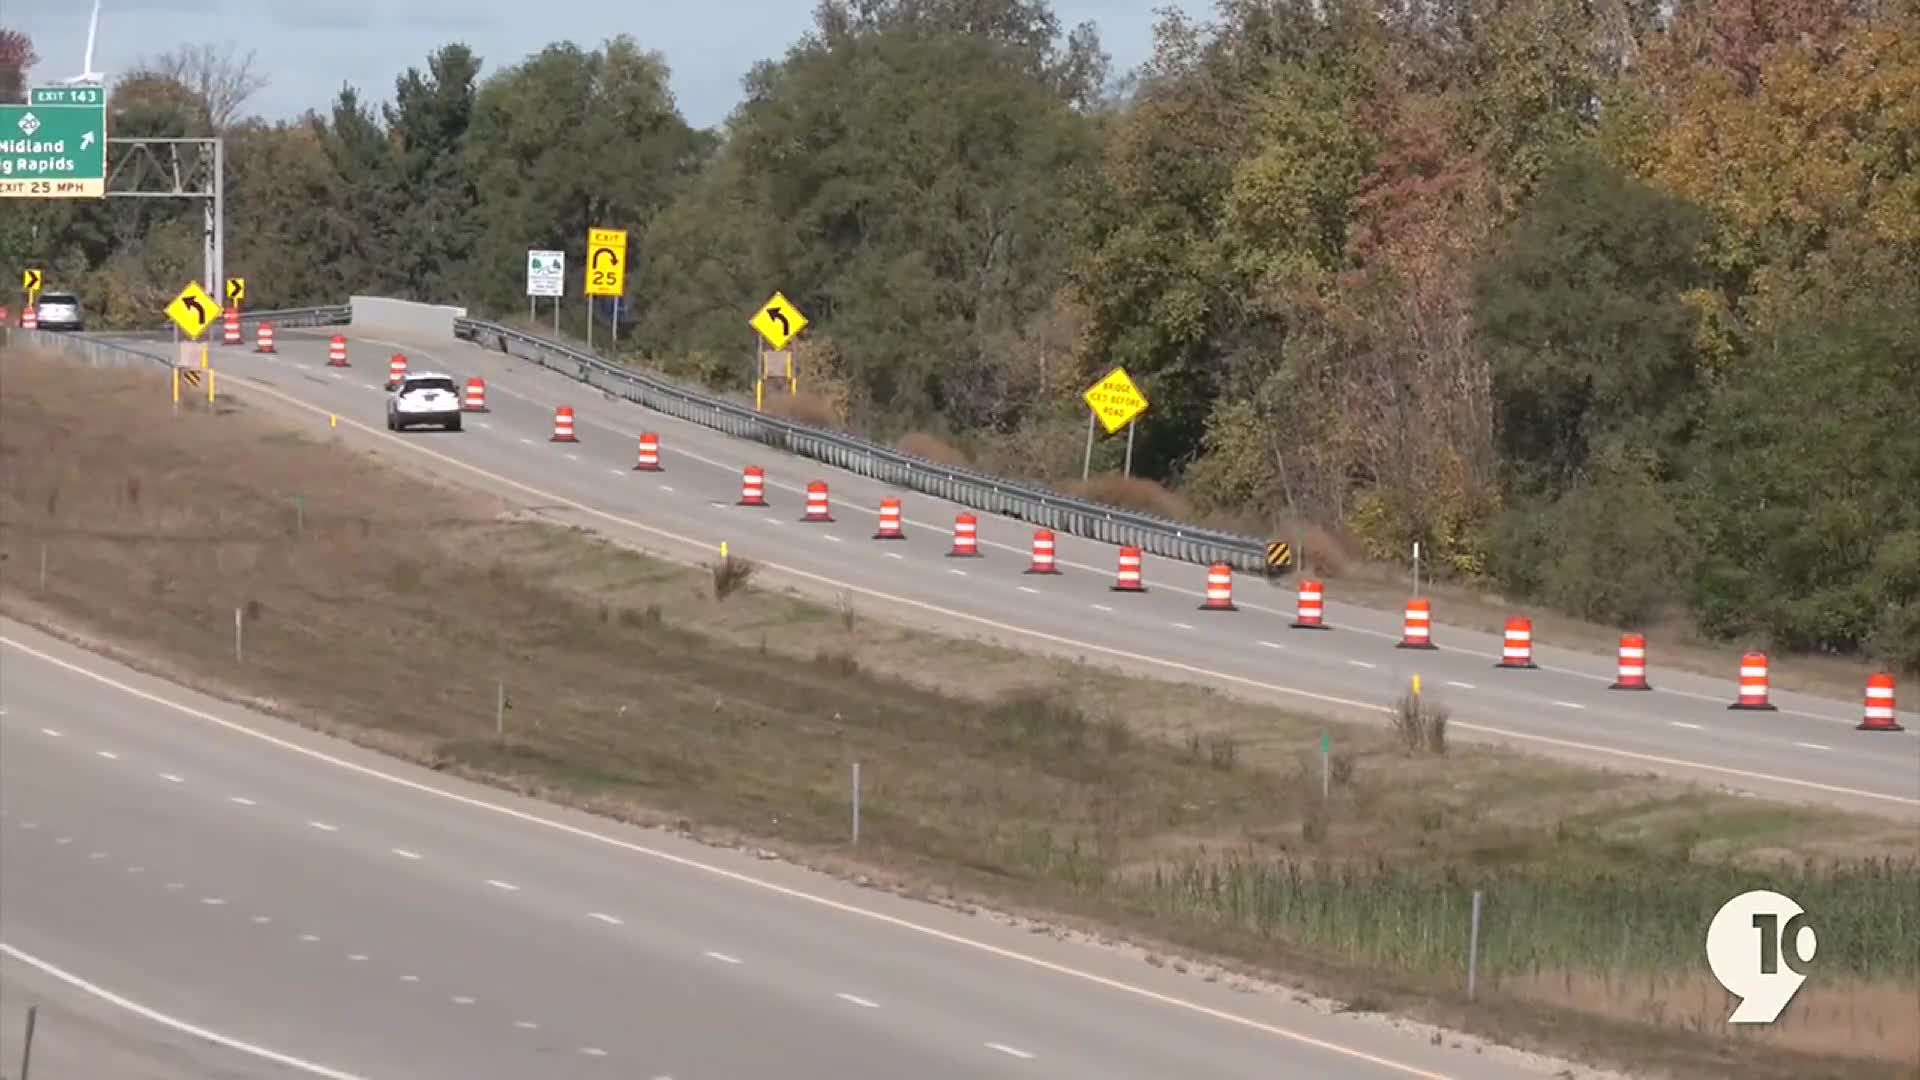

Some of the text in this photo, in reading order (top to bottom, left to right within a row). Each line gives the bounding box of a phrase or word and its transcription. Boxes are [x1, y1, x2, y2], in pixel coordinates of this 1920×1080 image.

[37, 90, 96, 102] EXIT 143
[22, 118, 37, 129] 20
[0, 139, 65, 153] Midland
[16, 157, 75, 174] Rapids
[31, 181, 51, 194] 25
[57, 183, 84, 193] MPH
[595, 233, 620, 242] EXIT
[592, 271, 617, 286] 25
